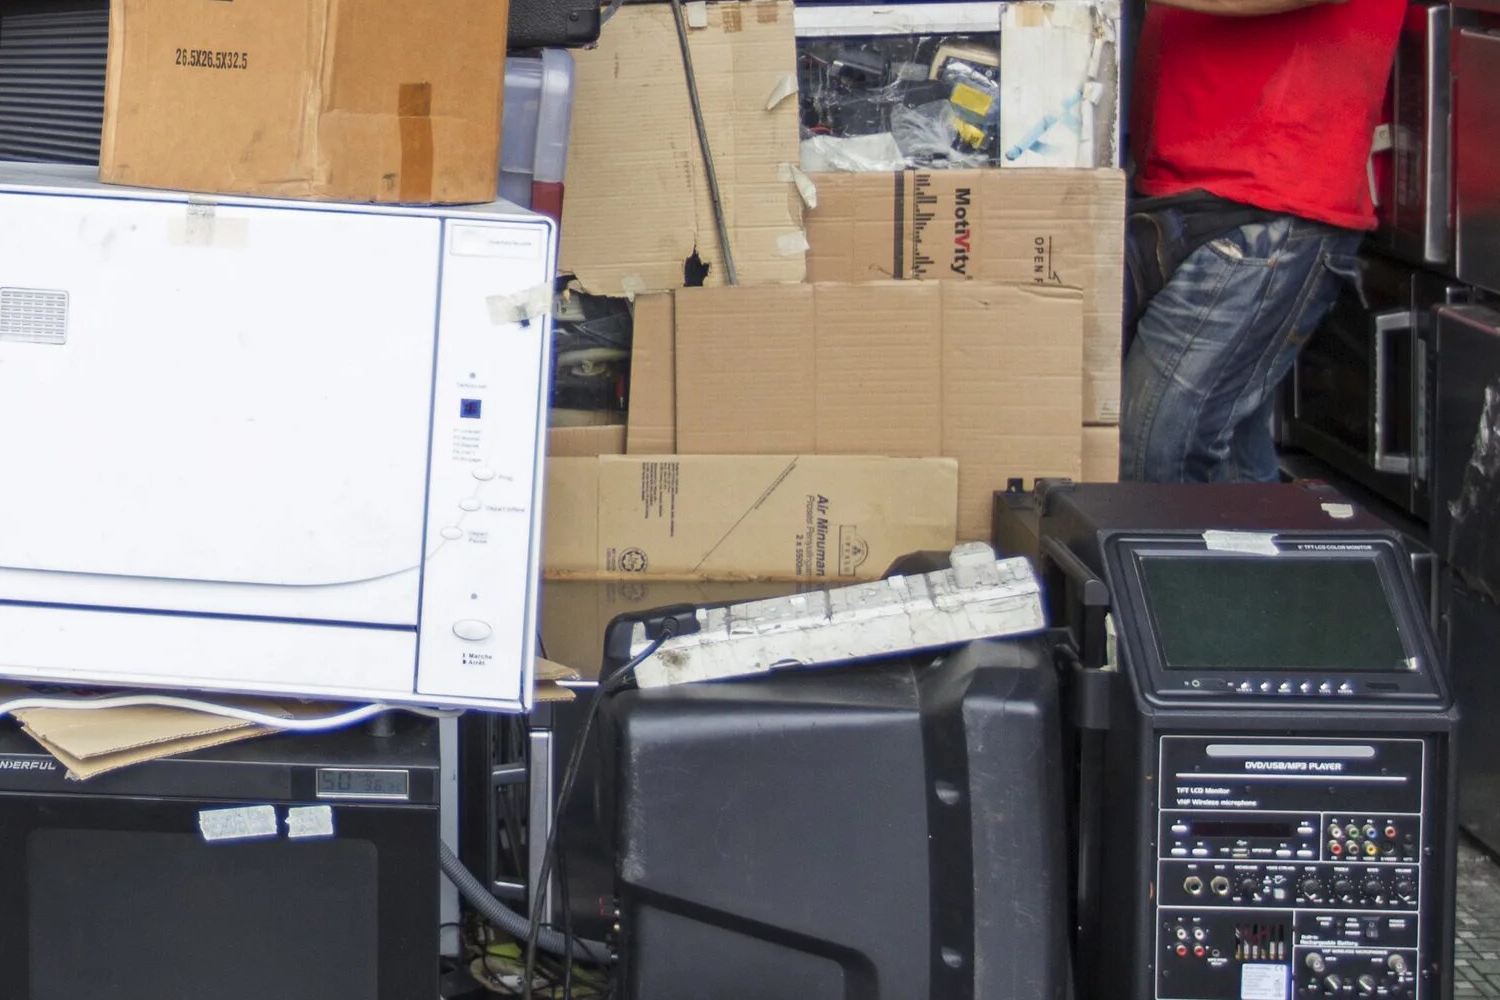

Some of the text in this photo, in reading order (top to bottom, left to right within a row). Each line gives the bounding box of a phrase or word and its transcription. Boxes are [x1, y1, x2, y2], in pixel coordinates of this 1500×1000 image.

[175, 48, 248, 70] 26.5X26.5X32.5
[1034, 236, 1045, 273] OPEN
[816, 493, 829, 577] Air Minuman
[1244, 761, 1343, 771] DVD/USB/MP3 PLAYER
